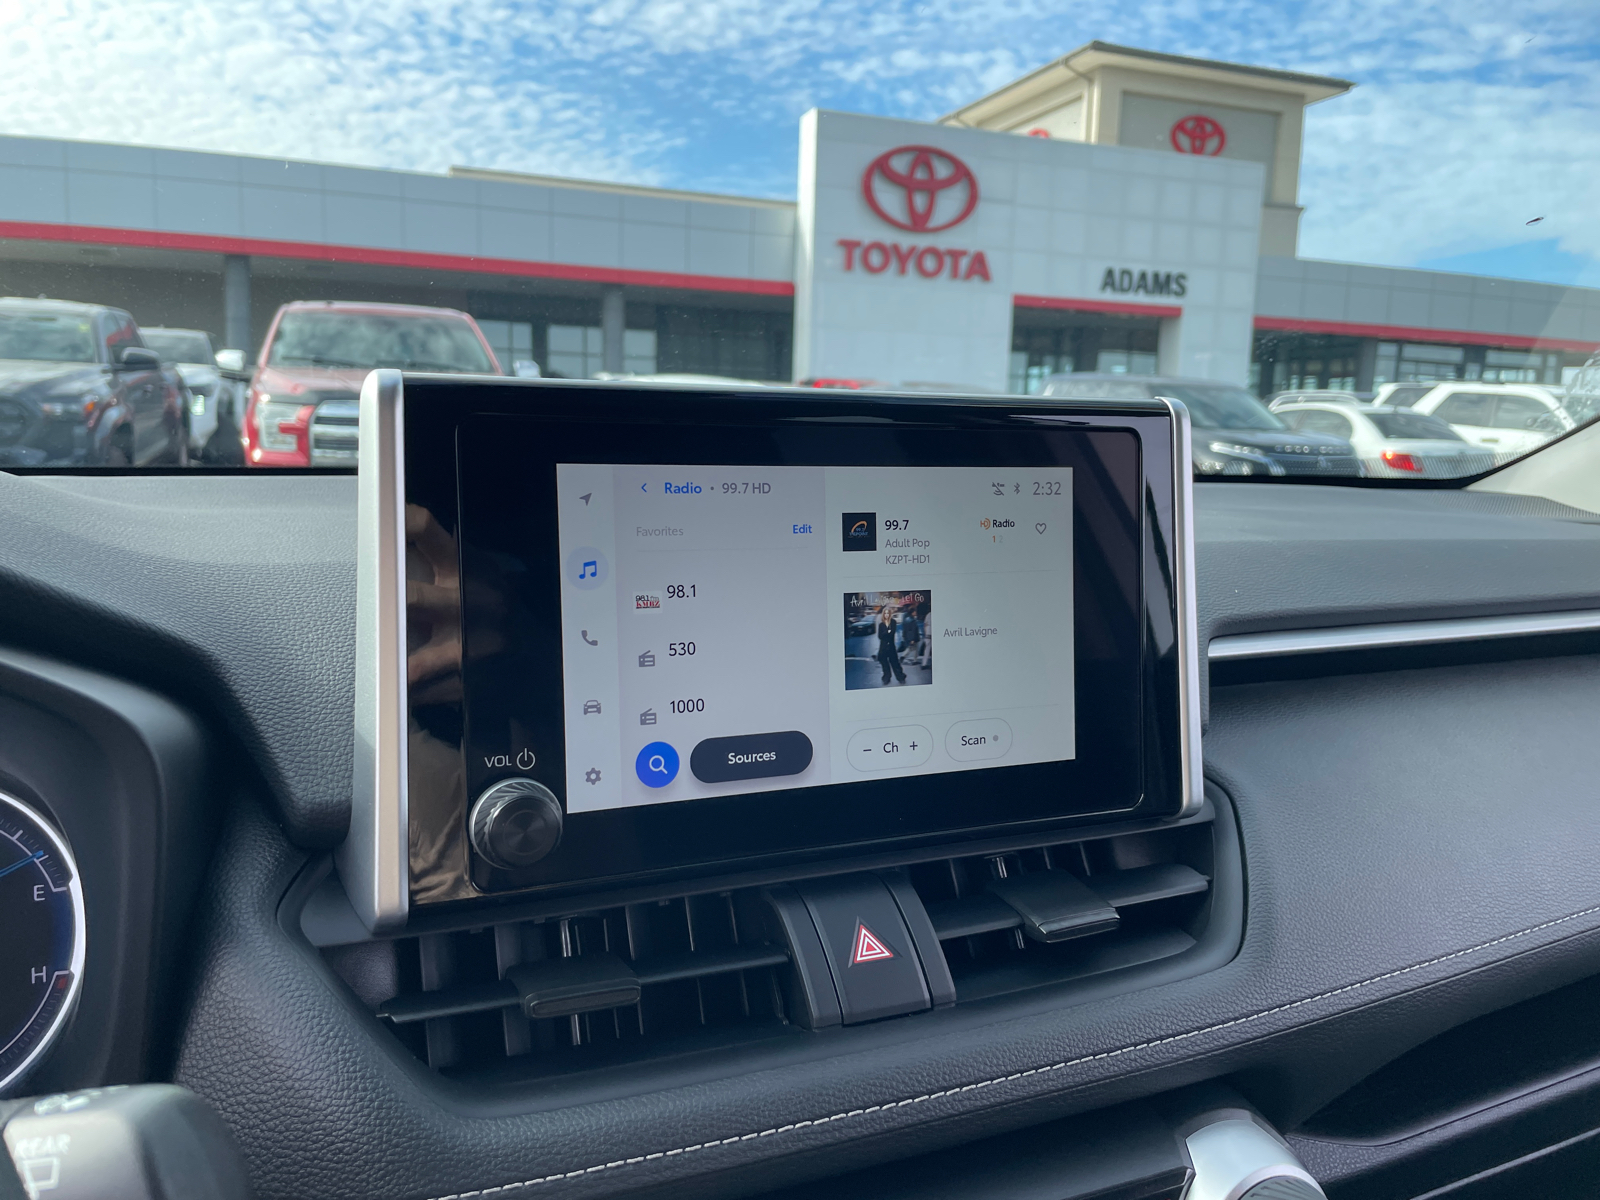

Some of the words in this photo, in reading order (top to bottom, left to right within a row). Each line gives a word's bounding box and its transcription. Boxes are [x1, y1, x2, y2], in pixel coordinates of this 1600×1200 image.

[838, 239, 992, 282] TOYOTA
[1100, 266, 1188, 298] ADAMS
[664, 482, 702, 495] Radio
[722, 483, 749, 495] 99.7
[752, 483, 772, 494] HD
[1032, 482, 1062, 496] 2:32
[792, 524, 813, 534] Edit
[884, 519, 909, 531] 99.7
[992, 519, 1016, 528] Radio
[636, 526, 684, 538] Favorites
[885, 538, 910, 548] Adult
[912, 538, 931, 549] Pop
[992, 535, 996, 543] 1
[885, 555, 930, 565] KZPT-HD1
[666, 584, 697, 599] 98.1
[943, 626, 963, 638] Avril
[964, 626, 998, 639] Lavigne
[669, 641, 697, 657] 530
[669, 698, 705, 714] 1000
[961, 734, 986, 746] Scan
[883, 742, 899, 753] Ch
[484, 755, 512, 768] VOL
[728, 750, 776, 765] Sources
[34, 884, 45, 901] E
[31, 966, 47, 984] H
